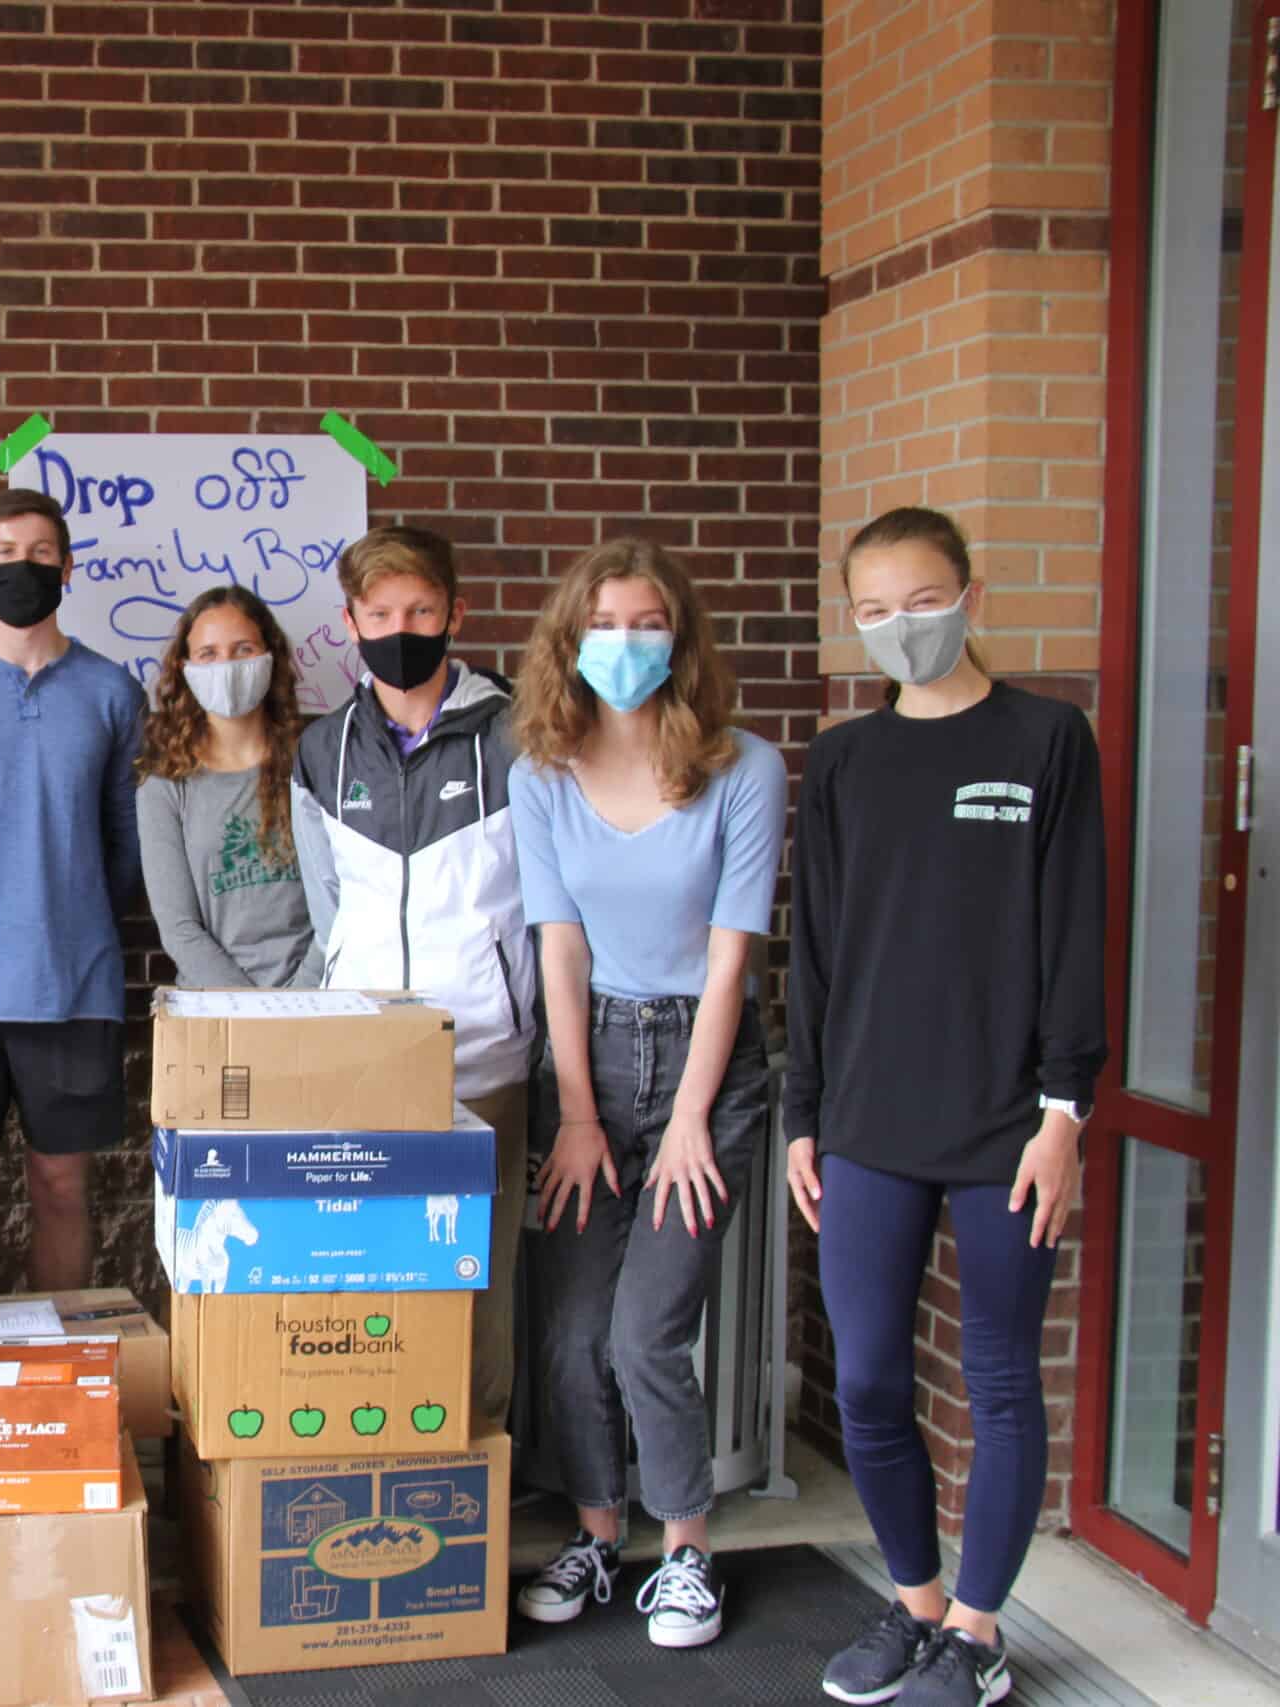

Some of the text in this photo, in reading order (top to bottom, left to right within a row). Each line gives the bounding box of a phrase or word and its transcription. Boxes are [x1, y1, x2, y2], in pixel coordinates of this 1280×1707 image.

[35, 446, 154, 527] Drop
[64, 528, 346, 606] Family Box
[286, 1151, 388, 1162] HAMMERMILL
[305, 1171, 333, 1184] Paper
[335, 1171, 349, 1182] for
[316, 1199, 359, 1213] Tidal
[274, 1311, 358, 1333] houston
[290, 1332, 406, 1355] foodbank
[15, 1423, 67, 1435] PLACE
